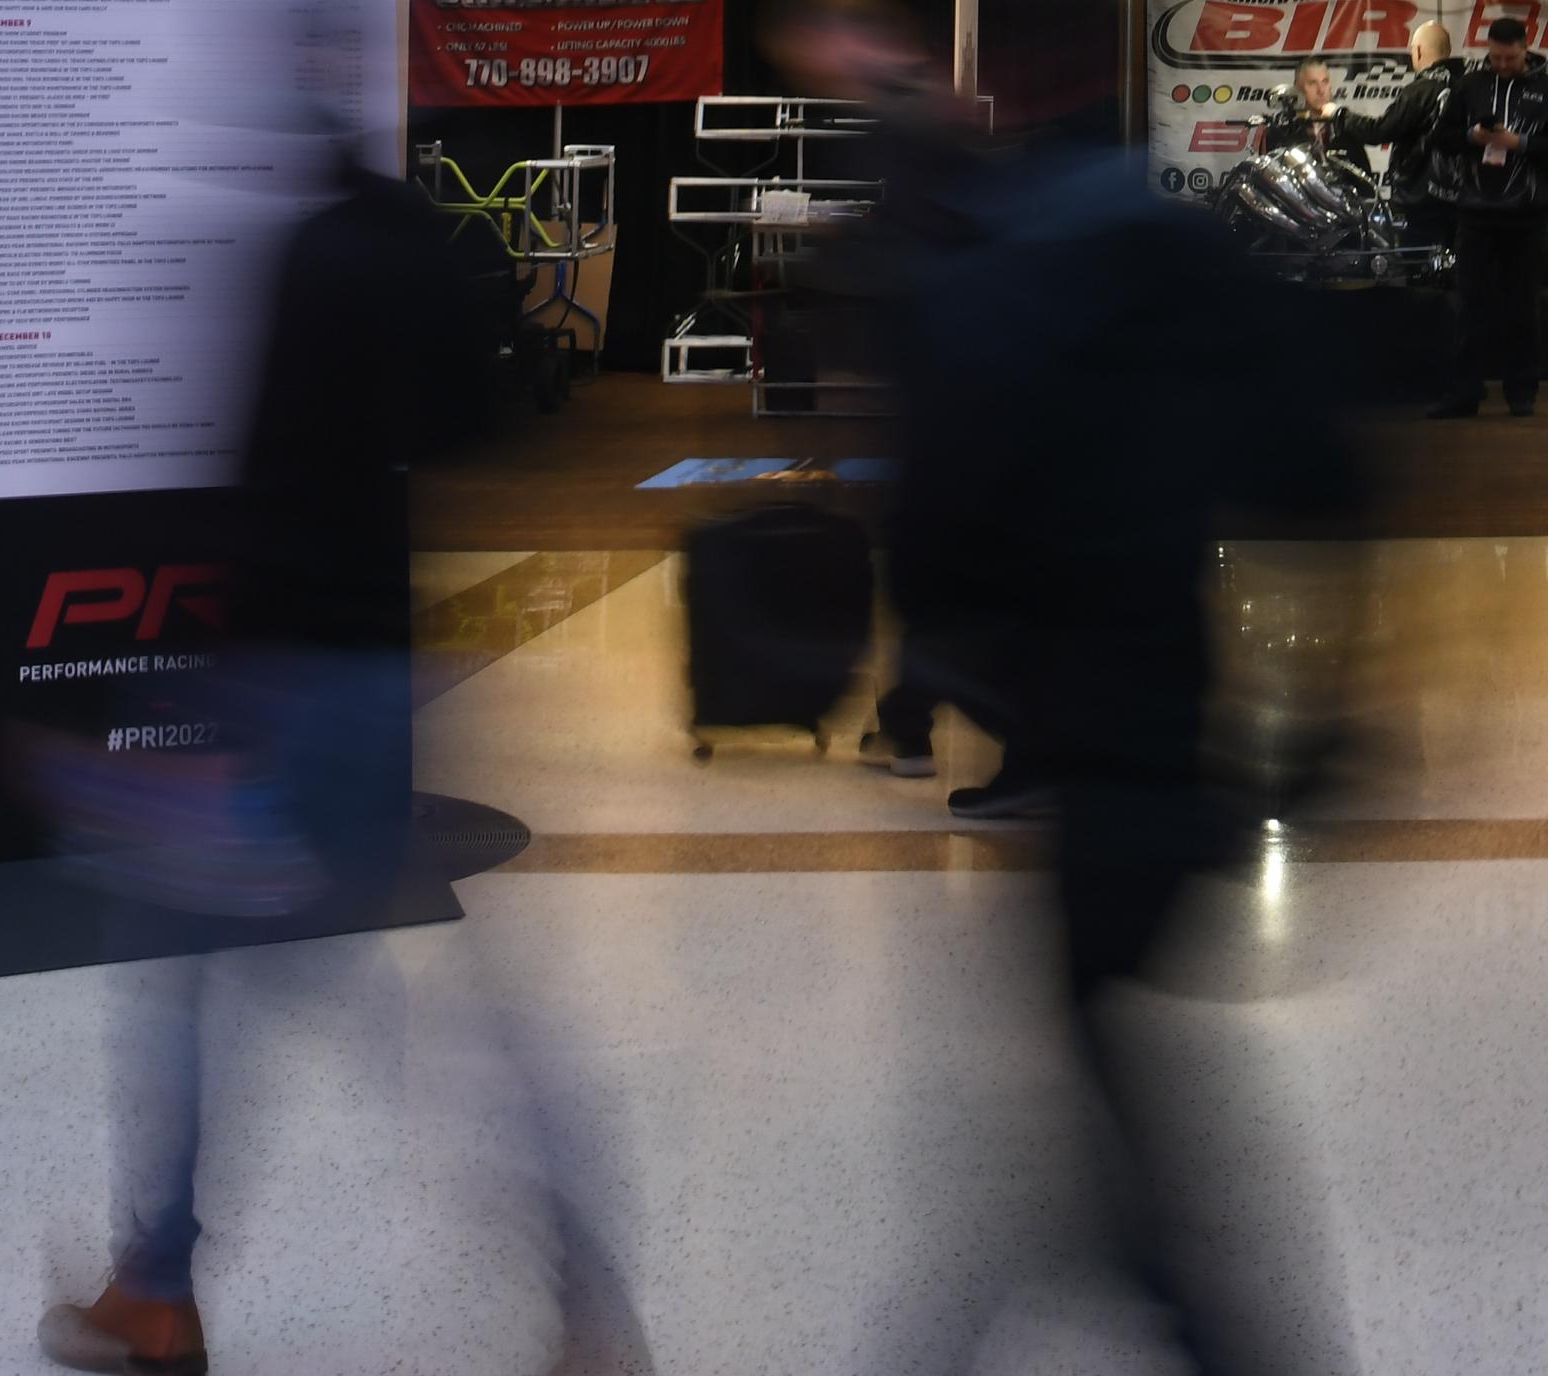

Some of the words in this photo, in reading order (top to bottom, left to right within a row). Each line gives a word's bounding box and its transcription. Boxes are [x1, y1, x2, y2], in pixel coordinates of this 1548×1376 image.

[464, 54, 650, 88] 770-898-3907
[25, 564, 228, 649] PR
[19, 655, 149, 683] PERFORMANCE
